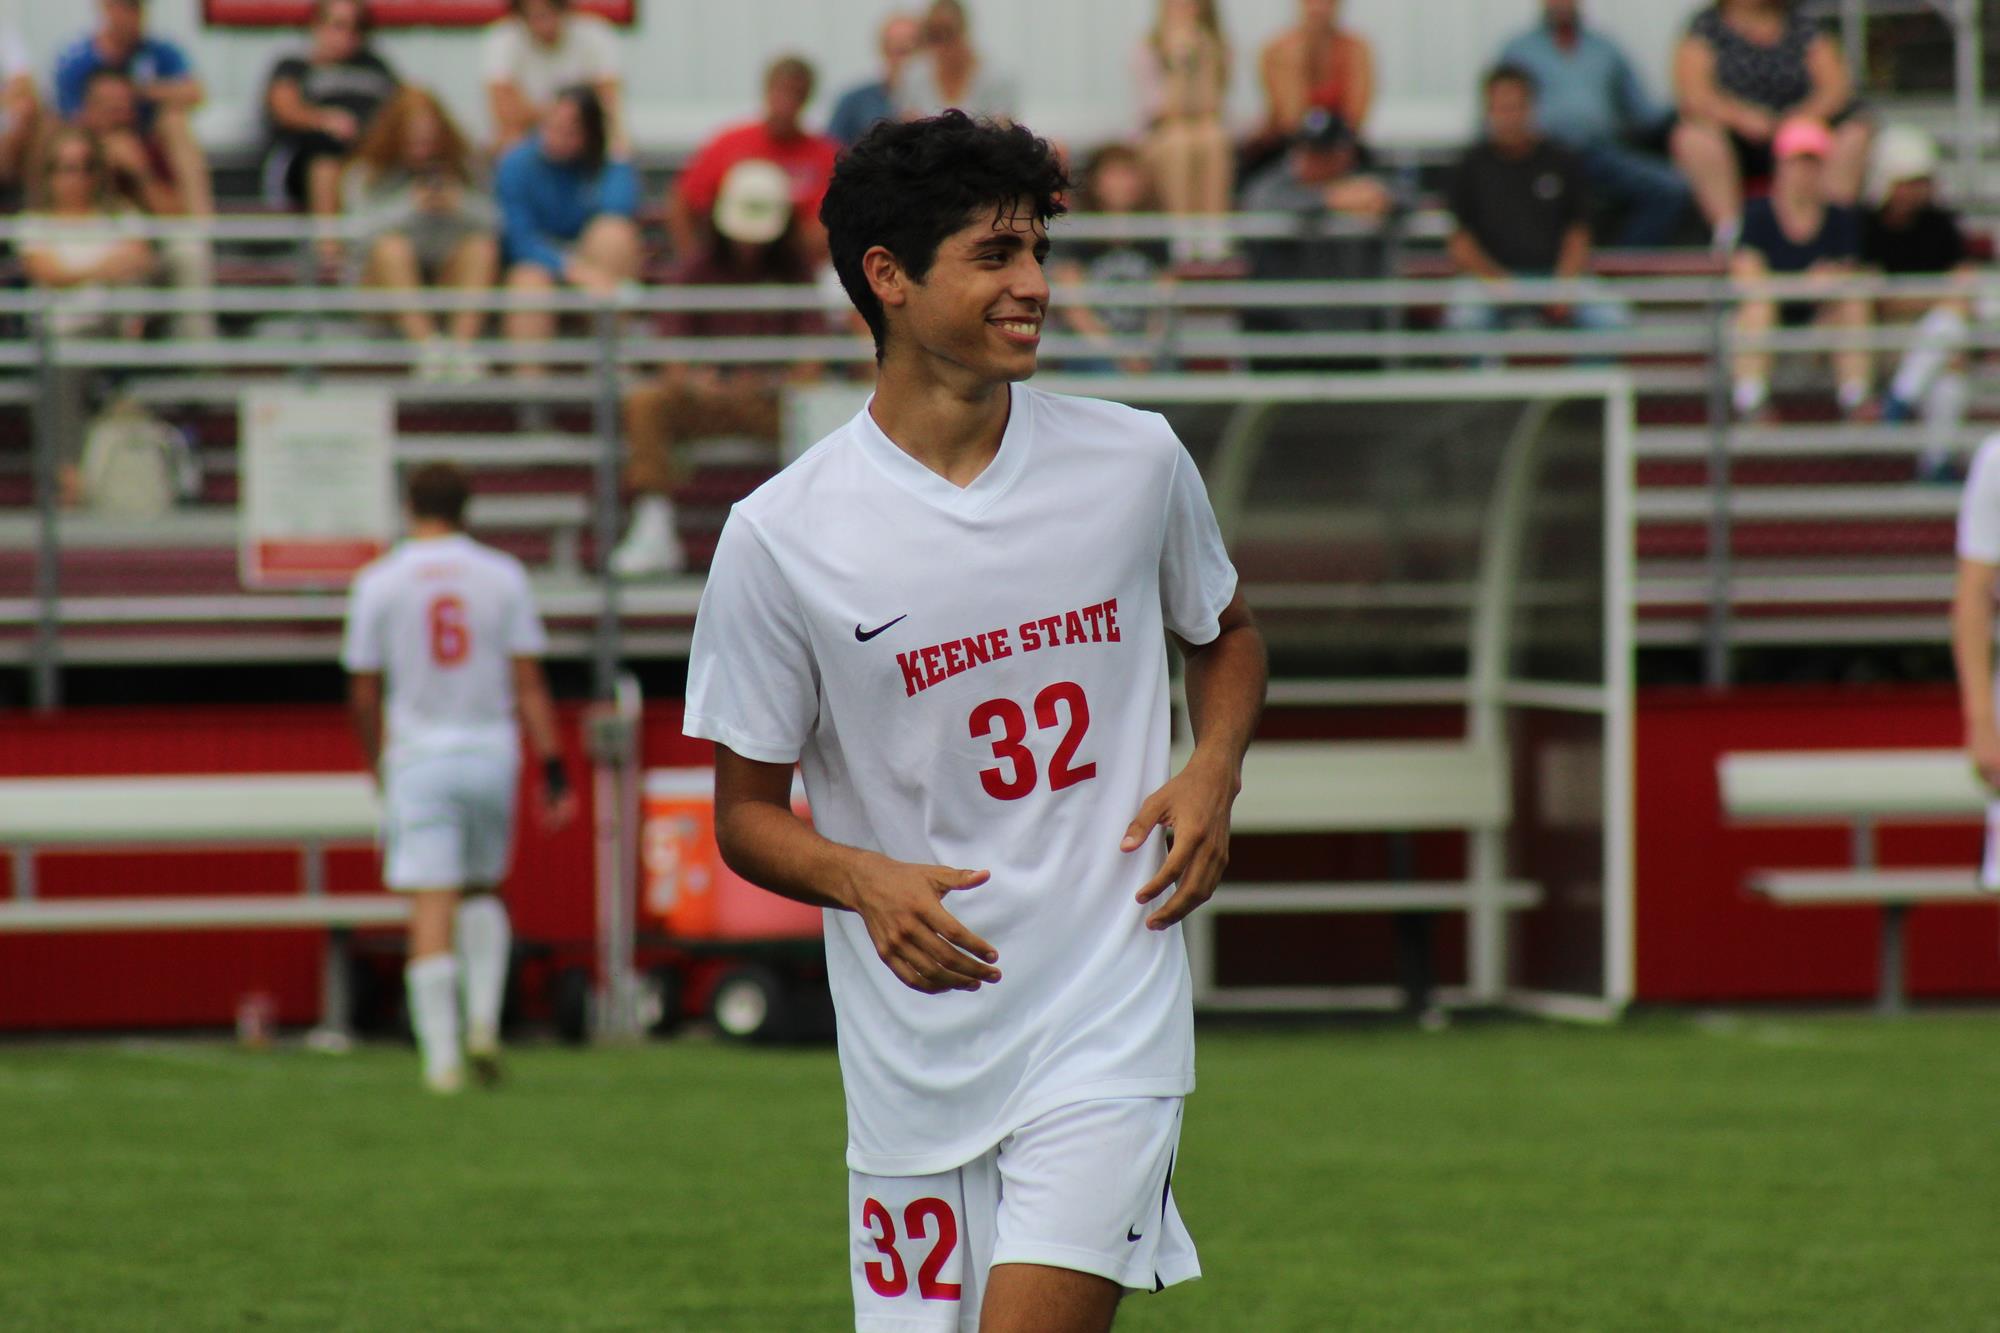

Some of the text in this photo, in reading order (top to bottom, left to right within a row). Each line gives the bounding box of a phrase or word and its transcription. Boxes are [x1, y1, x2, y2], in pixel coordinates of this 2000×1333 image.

[428, 594, 472, 668] 6
[896, 598, 1121, 697] KEENE STATE
[969, 681, 1096, 800] 32
[863, 1197, 961, 1300] 32
